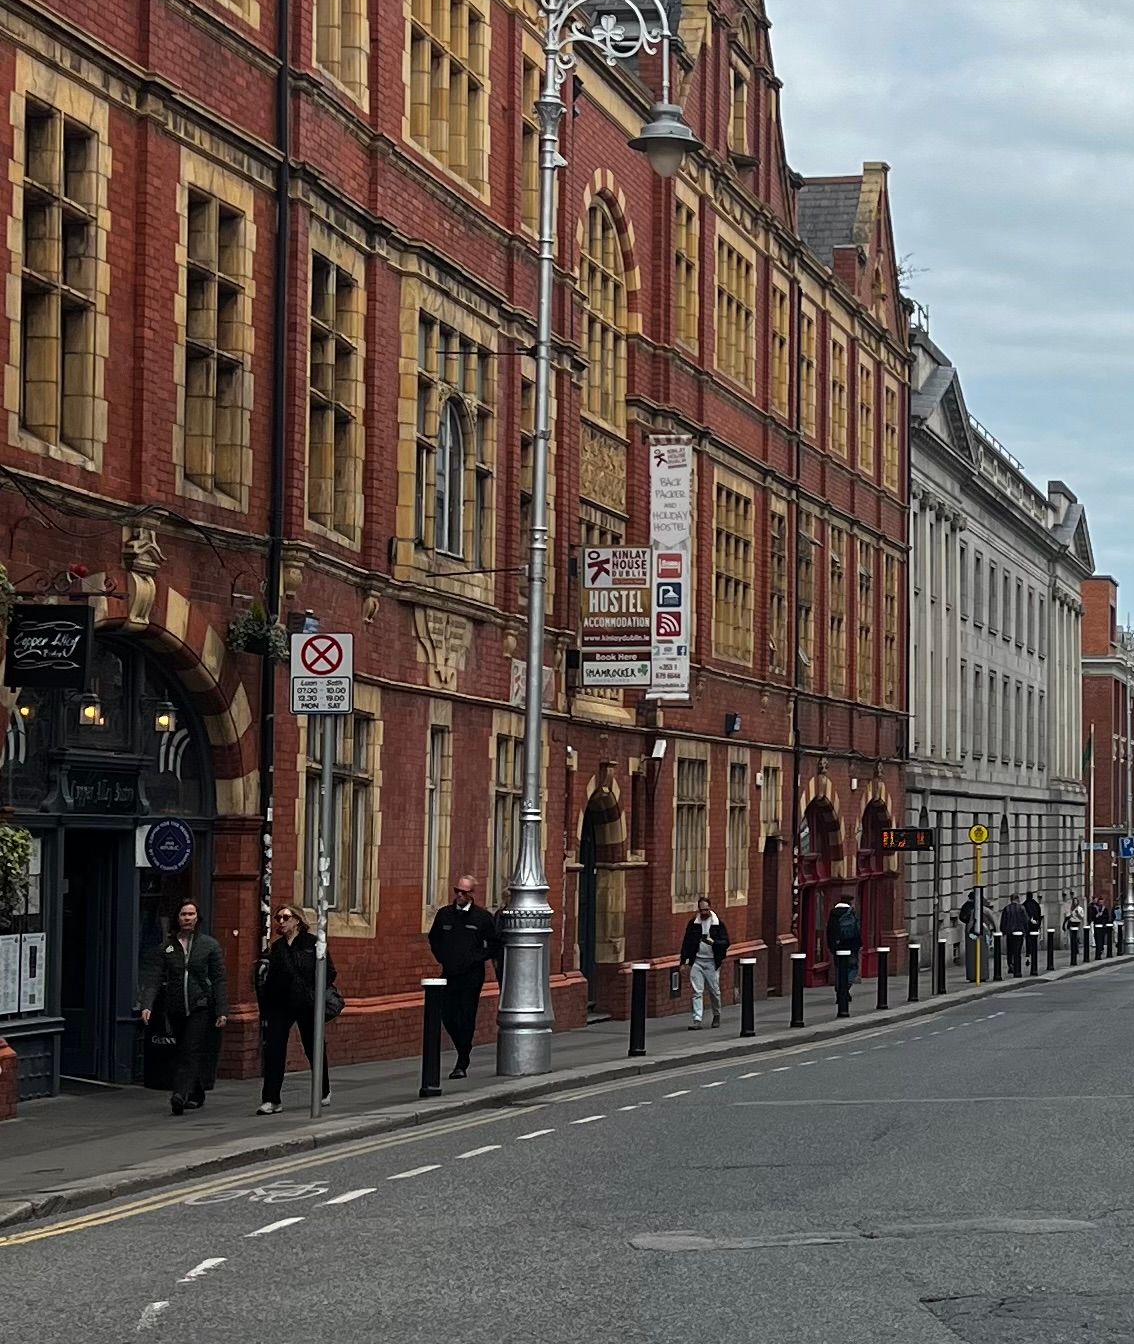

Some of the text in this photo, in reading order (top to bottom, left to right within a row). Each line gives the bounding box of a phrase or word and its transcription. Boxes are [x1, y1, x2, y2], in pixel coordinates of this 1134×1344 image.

[660, 478, 682, 487] BACK
[653, 511, 688, 521] HOLIDAY
[653, 523, 687, 532] HOSTEL
[612, 550, 647, 559] KINLAY
[612, 560, 647, 569] HOUSE
[589, 590, 643, 612] HOSTEL
[583, 617, 650, 627] ACCOMMODATION
[595, 653, 638, 661] Book Here
[585, 667, 637, 678] SHAMROCKER
